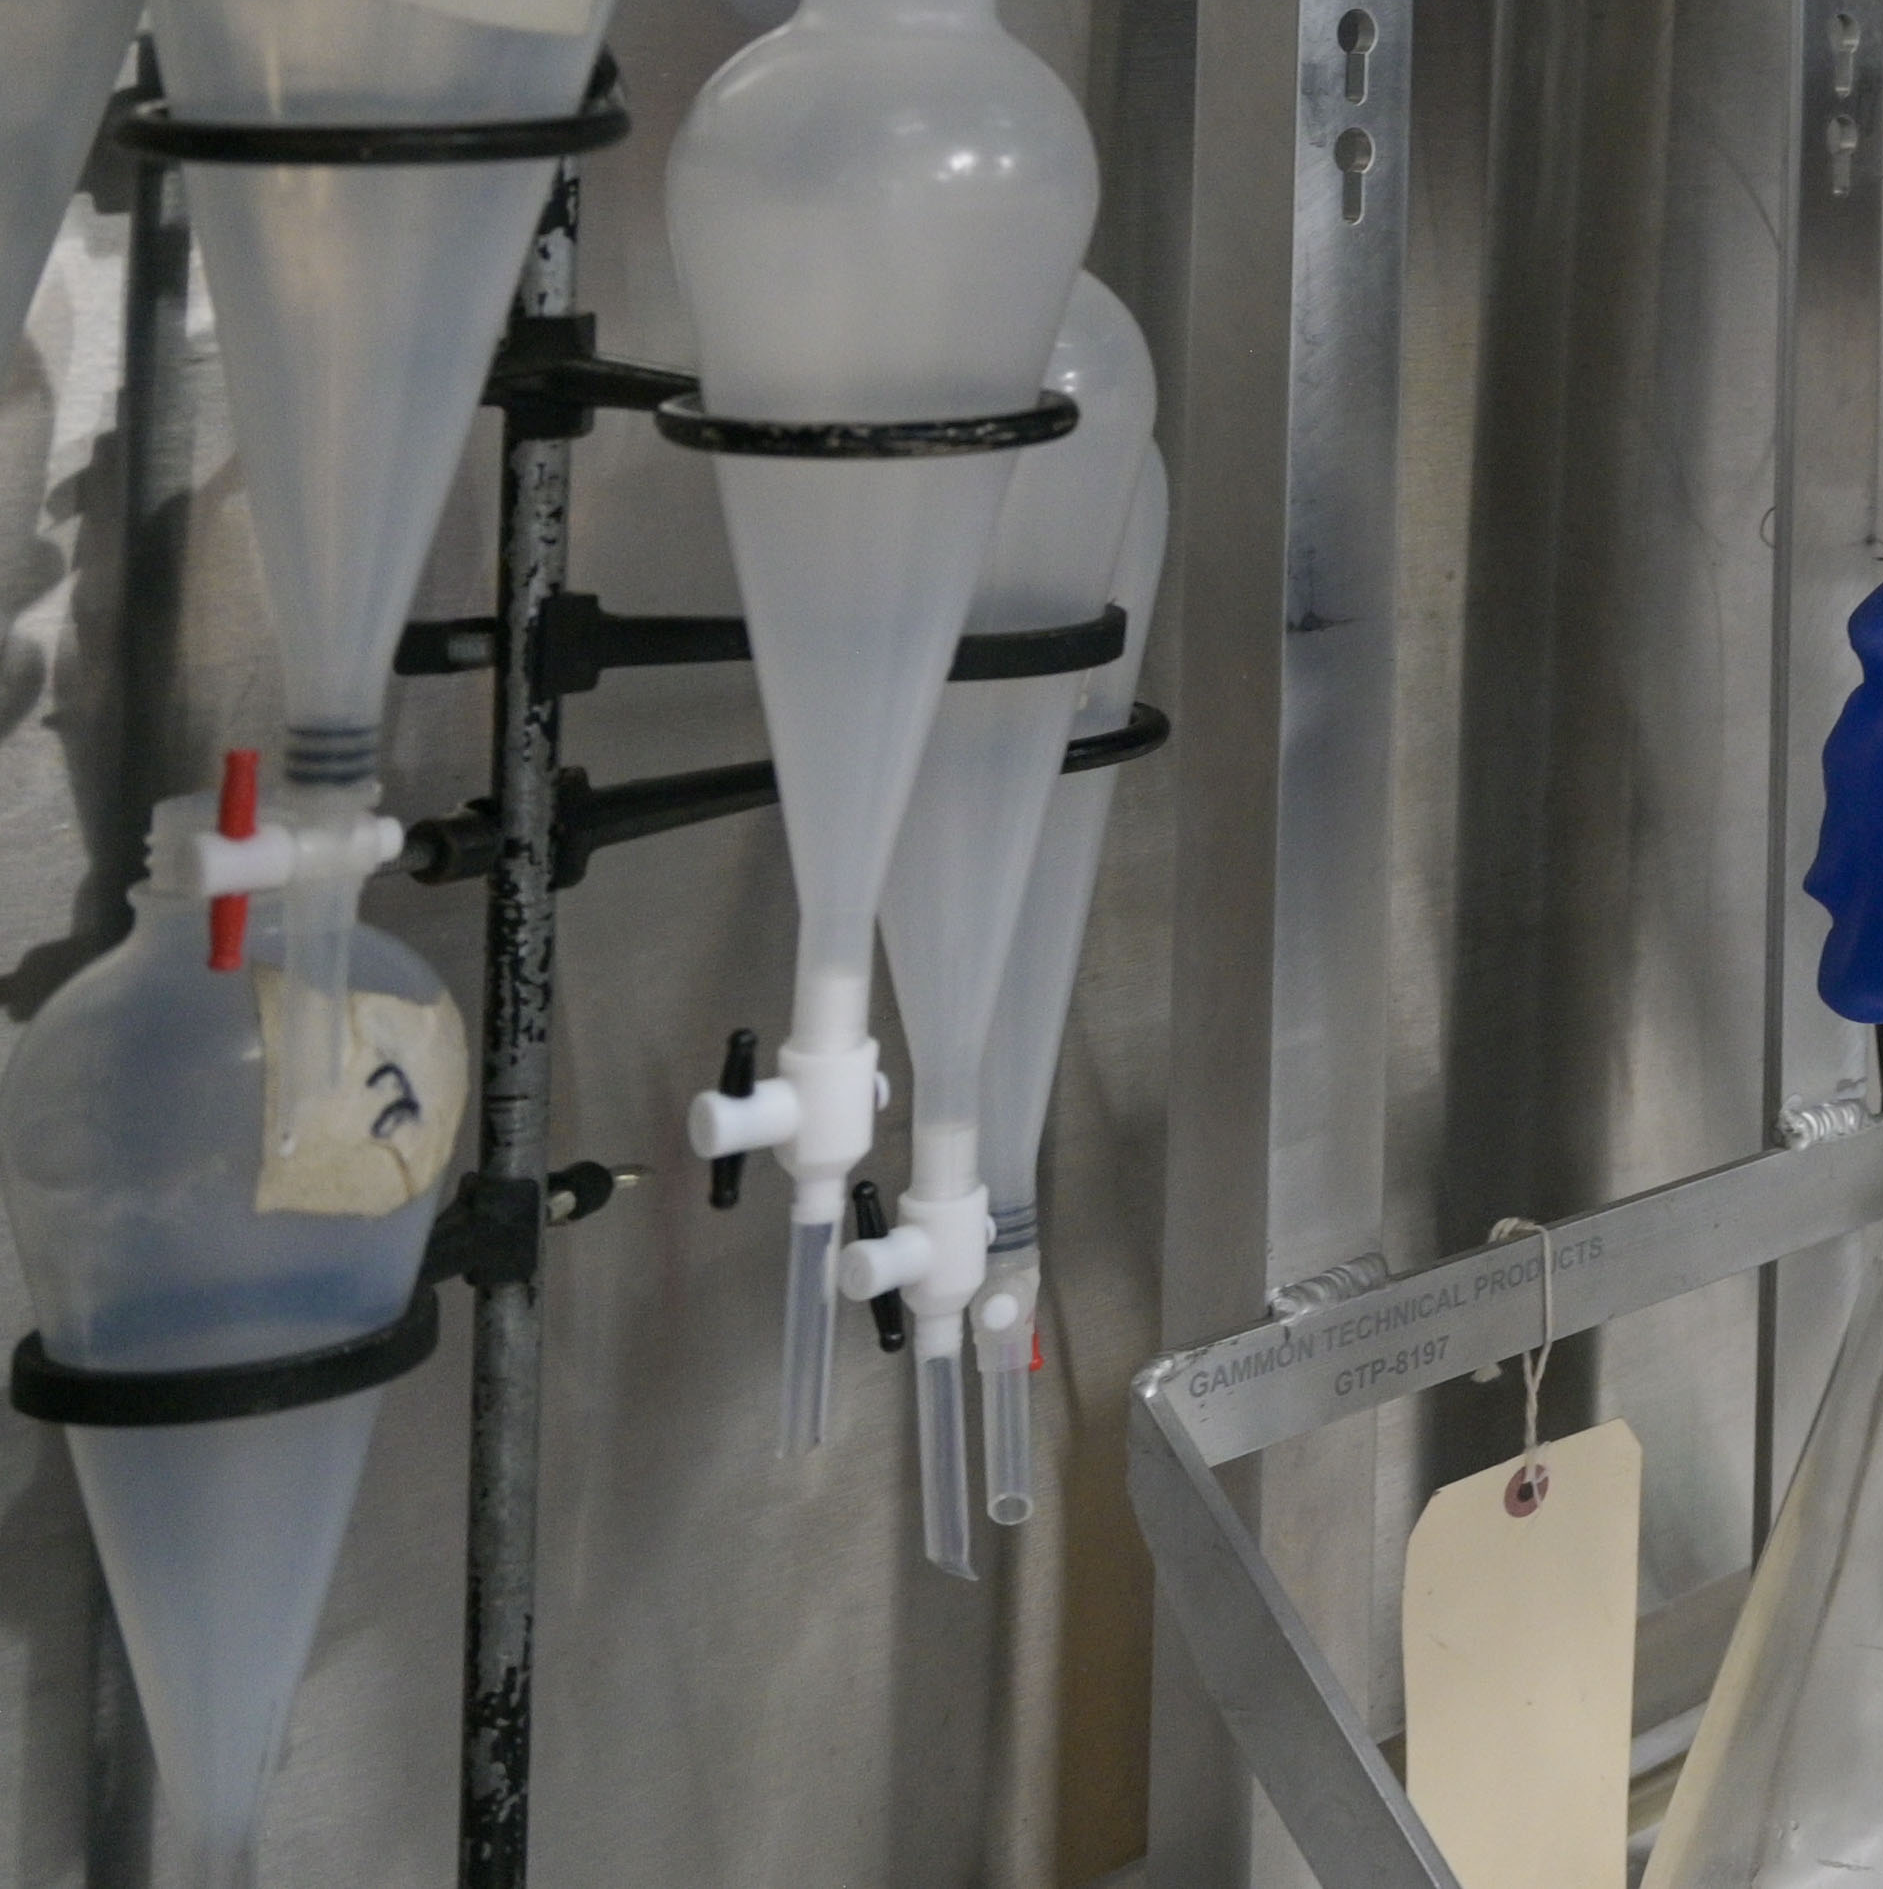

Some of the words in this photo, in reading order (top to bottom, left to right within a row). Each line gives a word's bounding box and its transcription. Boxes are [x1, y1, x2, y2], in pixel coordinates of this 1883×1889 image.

[1188, 1339, 1316, 1400] GAMMON
[1323, 1286, 1467, 1351] TECHNICAL
[1334, 1334, 1451, 1397] GTP-8197
